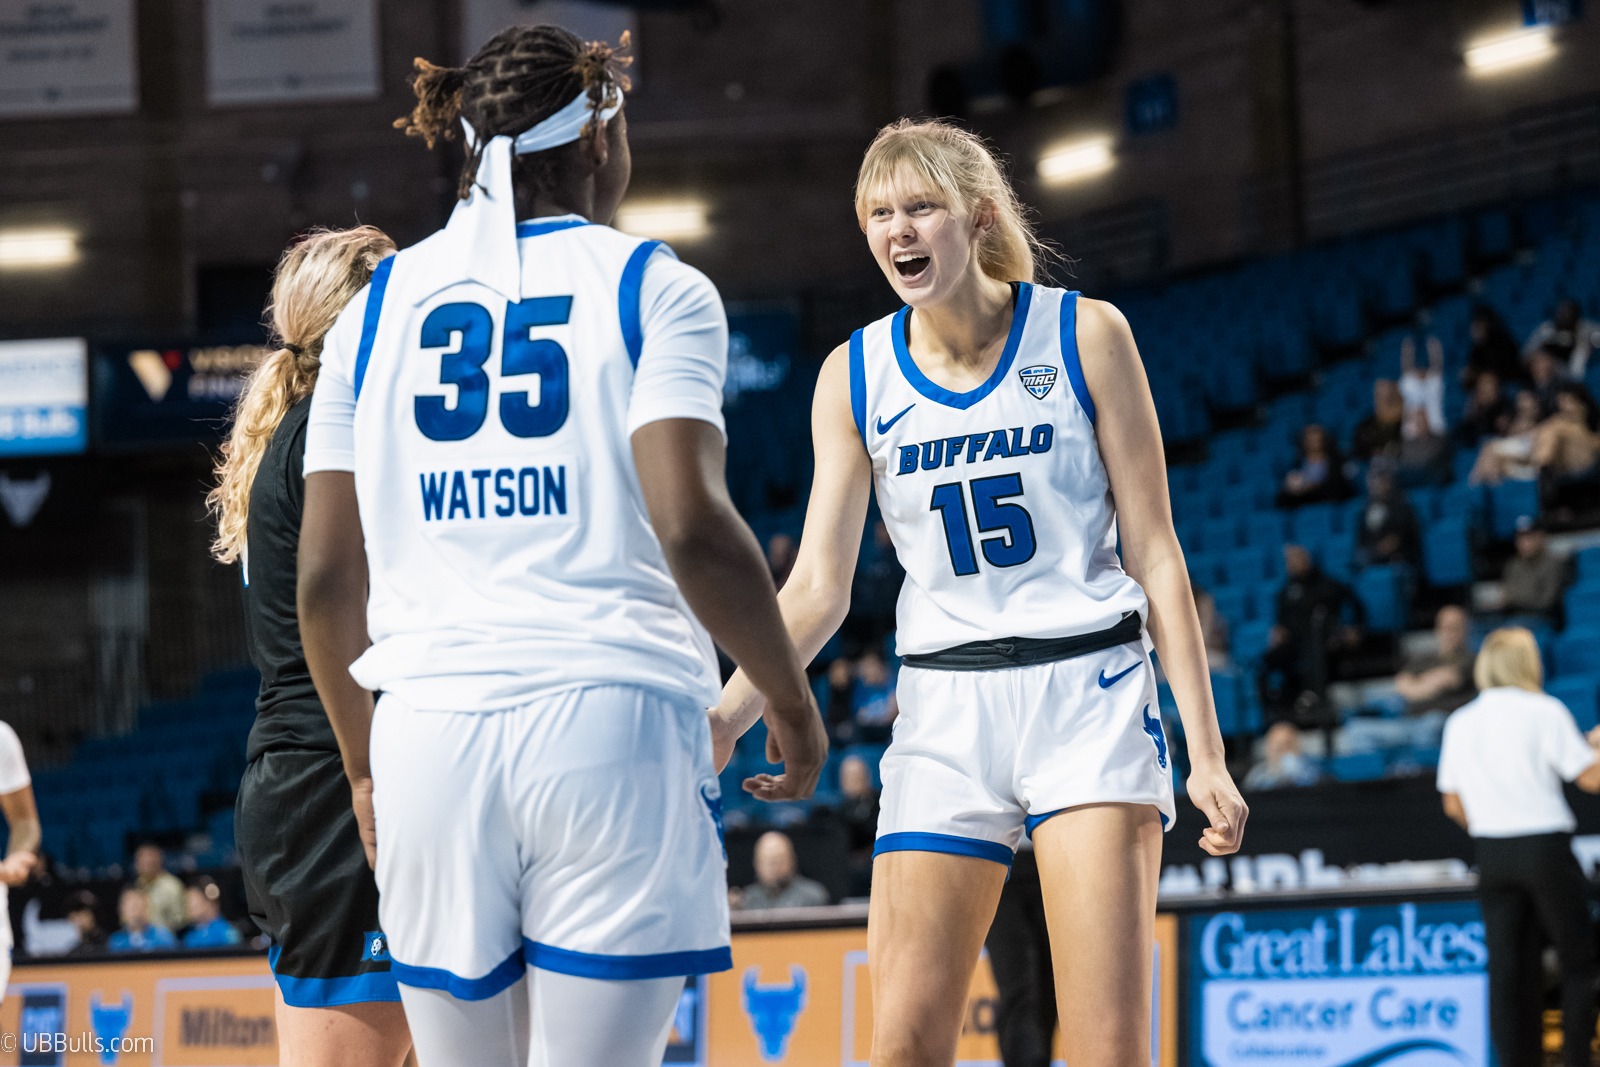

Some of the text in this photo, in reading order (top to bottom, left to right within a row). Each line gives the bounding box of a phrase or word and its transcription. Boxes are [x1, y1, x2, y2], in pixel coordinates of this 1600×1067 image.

[413, 294, 574, 442] 35
[1023, 374, 1055, 386] MAC
[896, 423, 1054, 476] BUFFALO
[419, 465, 567, 522] WATSON
[929, 472, 1037, 577] 15
[1202, 902, 1489, 978] Great Lakes
[1227, 985, 1459, 1032] Cancer Care
